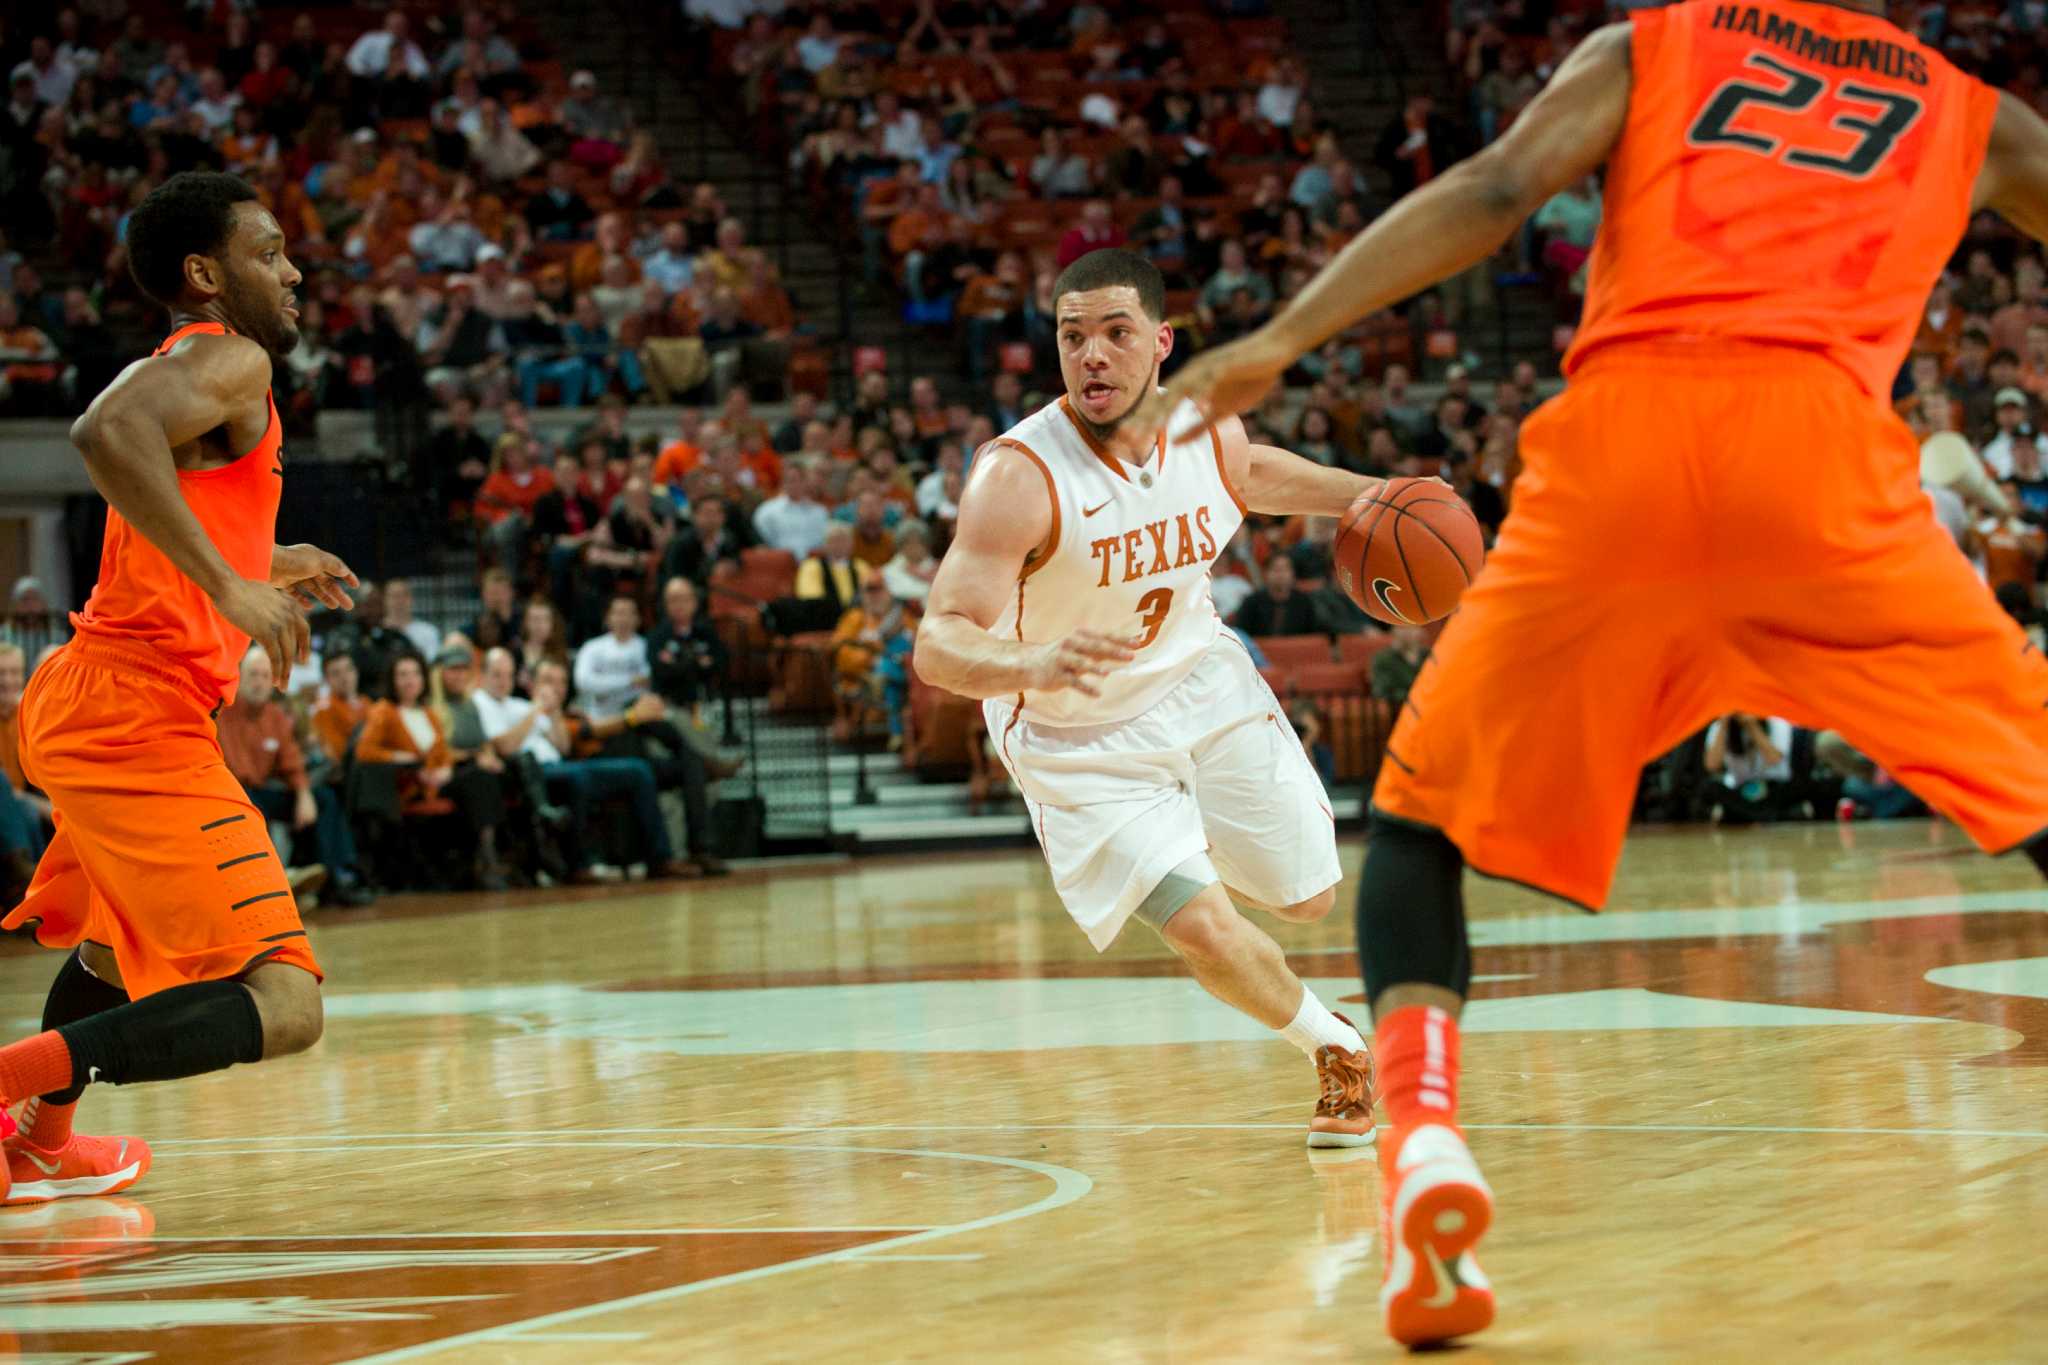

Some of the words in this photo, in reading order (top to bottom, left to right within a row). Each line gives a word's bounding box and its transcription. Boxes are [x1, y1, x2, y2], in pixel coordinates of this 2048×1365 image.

[1686, 49, 1925, 181] 23
[1089, 505, 1217, 588] TEXAS
[1135, 587, 1174, 651] 3
